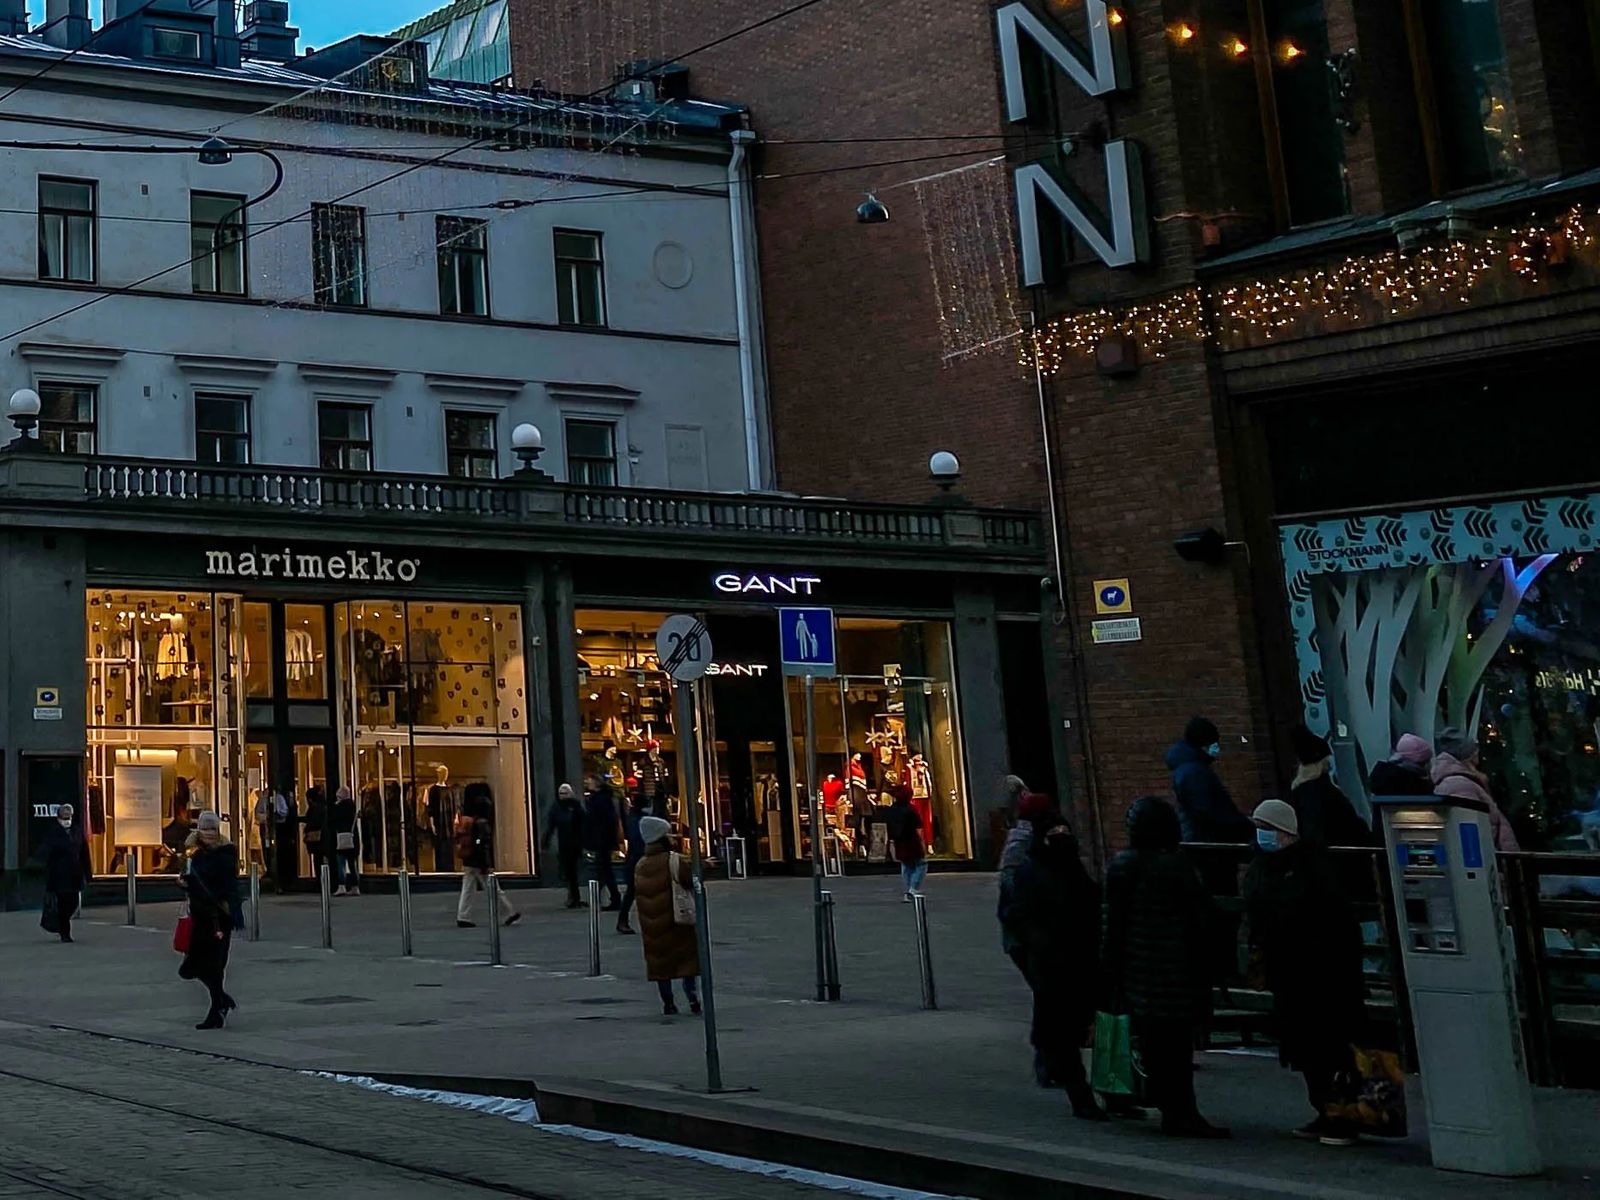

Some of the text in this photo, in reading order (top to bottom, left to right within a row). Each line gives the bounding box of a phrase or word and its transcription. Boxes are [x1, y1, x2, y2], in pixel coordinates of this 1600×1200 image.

[205, 548, 420, 582] marimekko
[1307, 543, 1390, 562] STOCKMANN
[714, 573, 822, 595] GANT
[668, 631, 702, 663] 20
